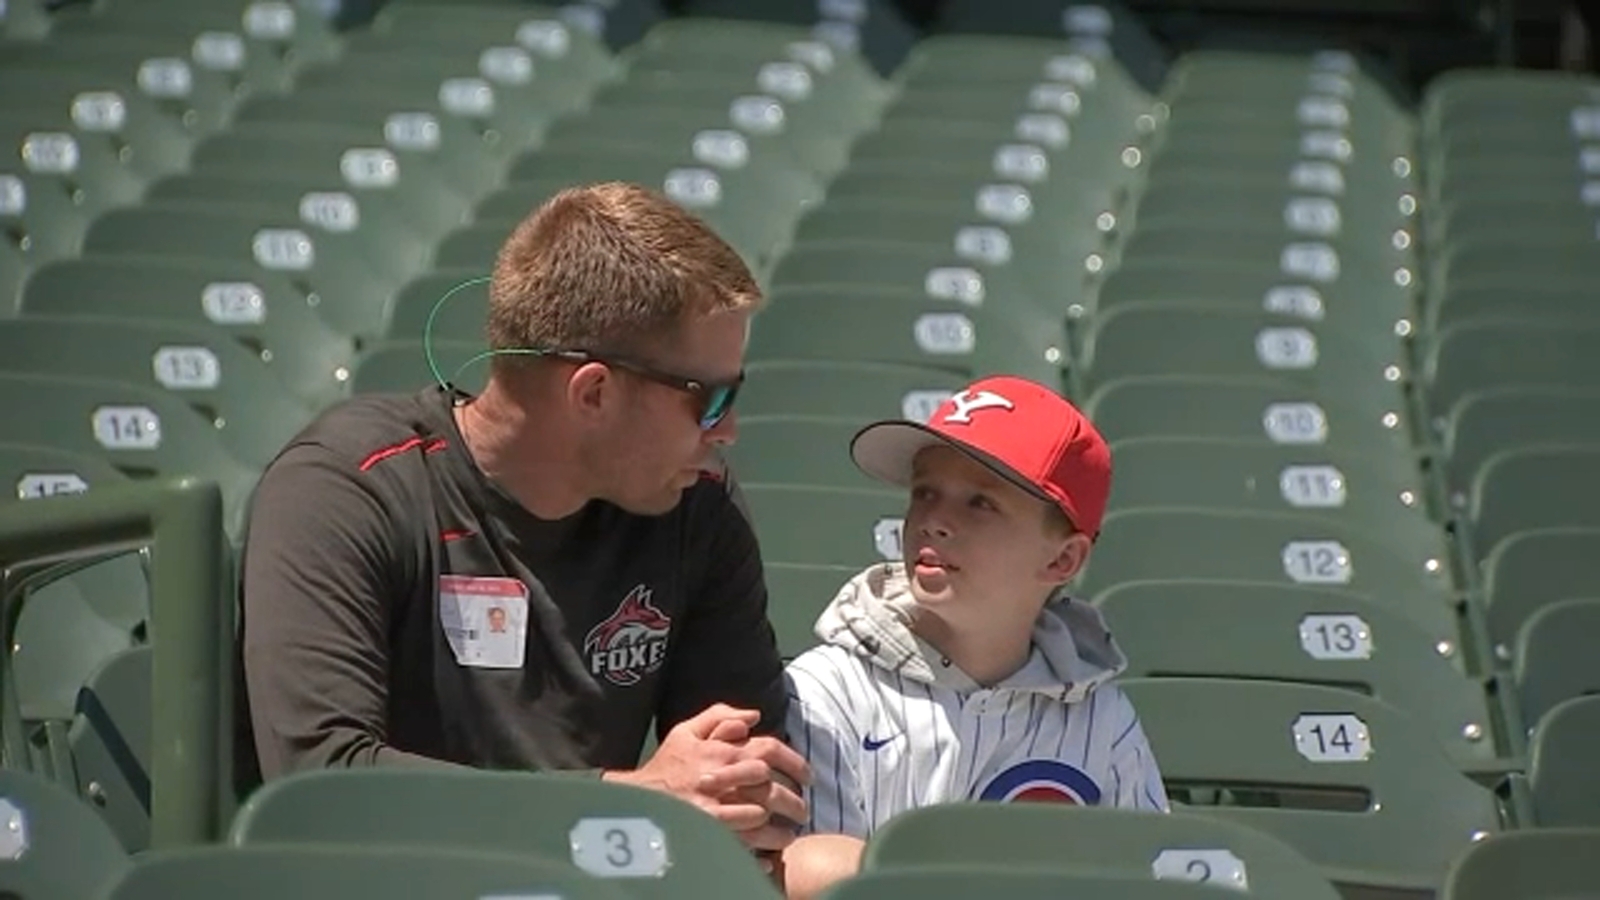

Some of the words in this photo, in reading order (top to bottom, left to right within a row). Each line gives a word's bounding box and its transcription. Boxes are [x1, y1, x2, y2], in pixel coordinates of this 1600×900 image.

[217, 290, 247, 313] 12
[168, 355, 203, 381] 13
[943, 389, 1014, 421] Y
[110, 415, 143, 440] 14
[1281, 411, 1314, 435] 10
[1296, 474, 1329, 499] 11
[1300, 549, 1335, 577] 12
[1315, 623, 1356, 653] 13
[1309, 723, 1353, 756] 14
[603, 828, 634, 868] 3
